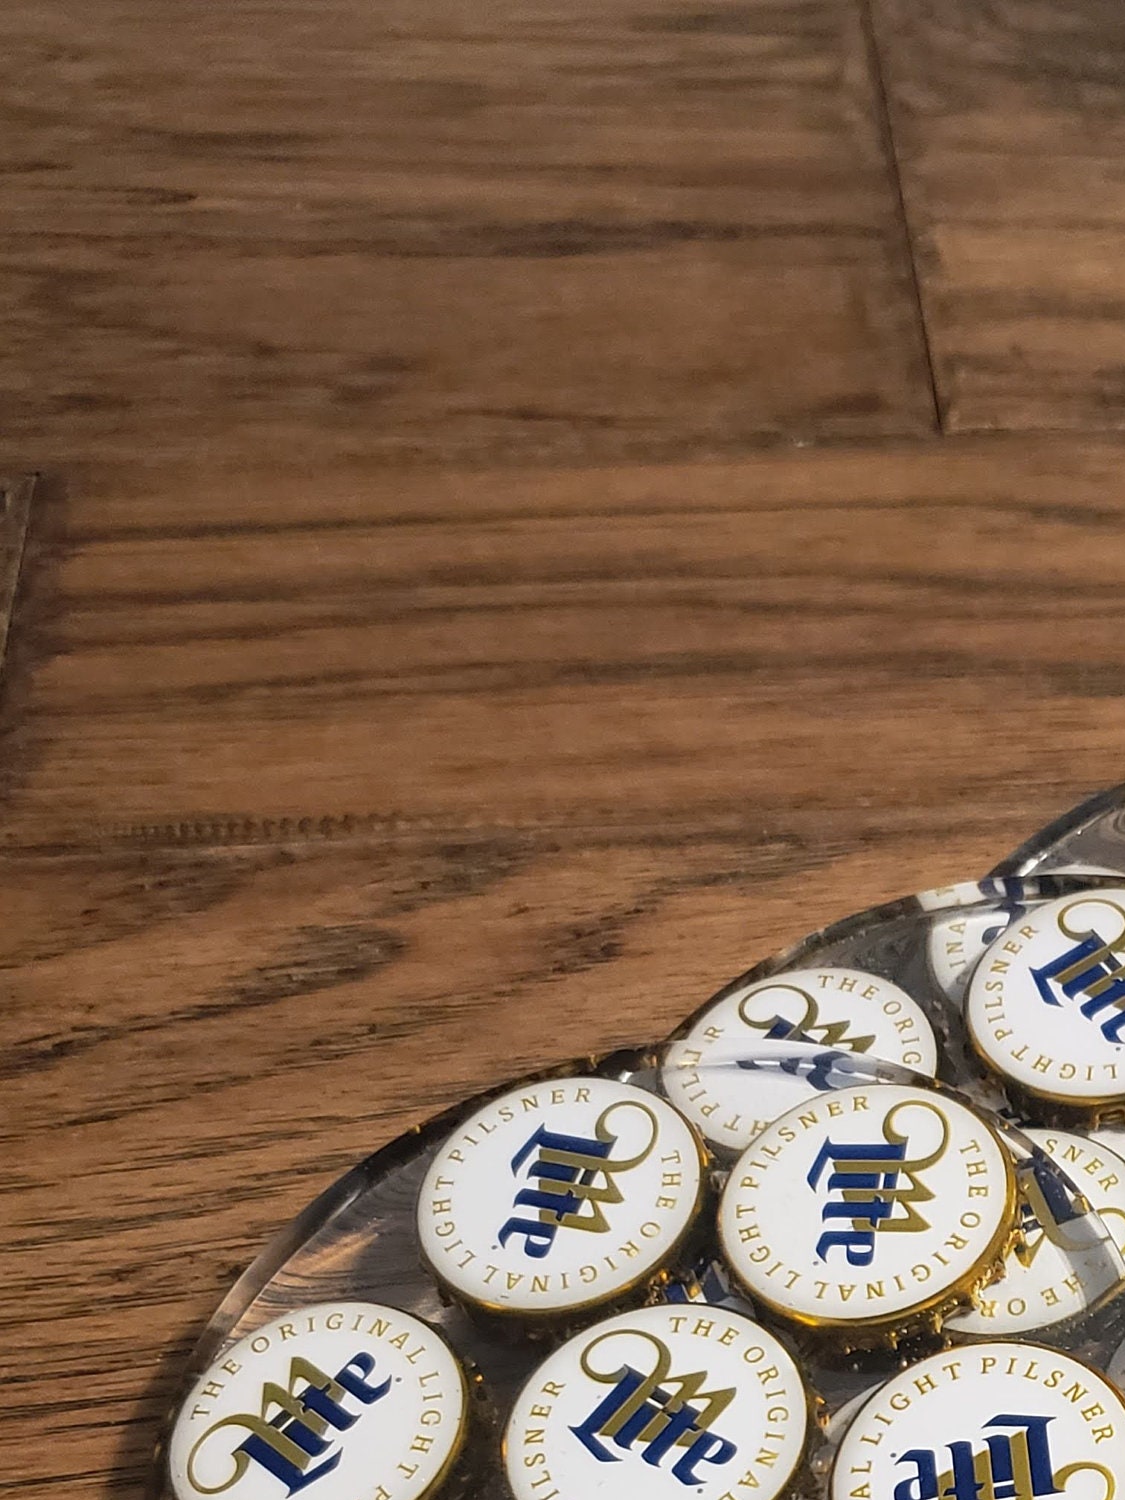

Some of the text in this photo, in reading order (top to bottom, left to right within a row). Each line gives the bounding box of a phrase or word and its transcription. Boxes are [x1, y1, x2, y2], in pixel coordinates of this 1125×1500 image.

[818, 975, 880, 1000] THE
[985, 926, 1040, 1041] PILSNER
[1011, 1045, 1119, 1081] LIGHT
[740, 1096, 869, 1189] PILSNER
[960, 1140, 988, 1197] THE
[433, 1088, 681, 1292] THE ORIGINAL LIGHT PILSNER
[498, 1123, 618, 1258] Lite
[807, 1136, 908, 1266] Lite
[736, 1205, 802, 1289] LIGHT
[815, 1213, 980, 1301] ORIGINAL
[669, 1316, 740, 1345] THE
[191, 1359, 242, 1420] THE
[251, 1313, 426, 1364] ORIGINAL
[398, 1372, 442, 1479] LIGHT
[231, 1352, 392, 1498] Lite
[568, 1364, 737, 1485] Lite
[861, 1362, 962, 1446] LIGHT
[981, 1357, 1115, 1443] PILSNER
